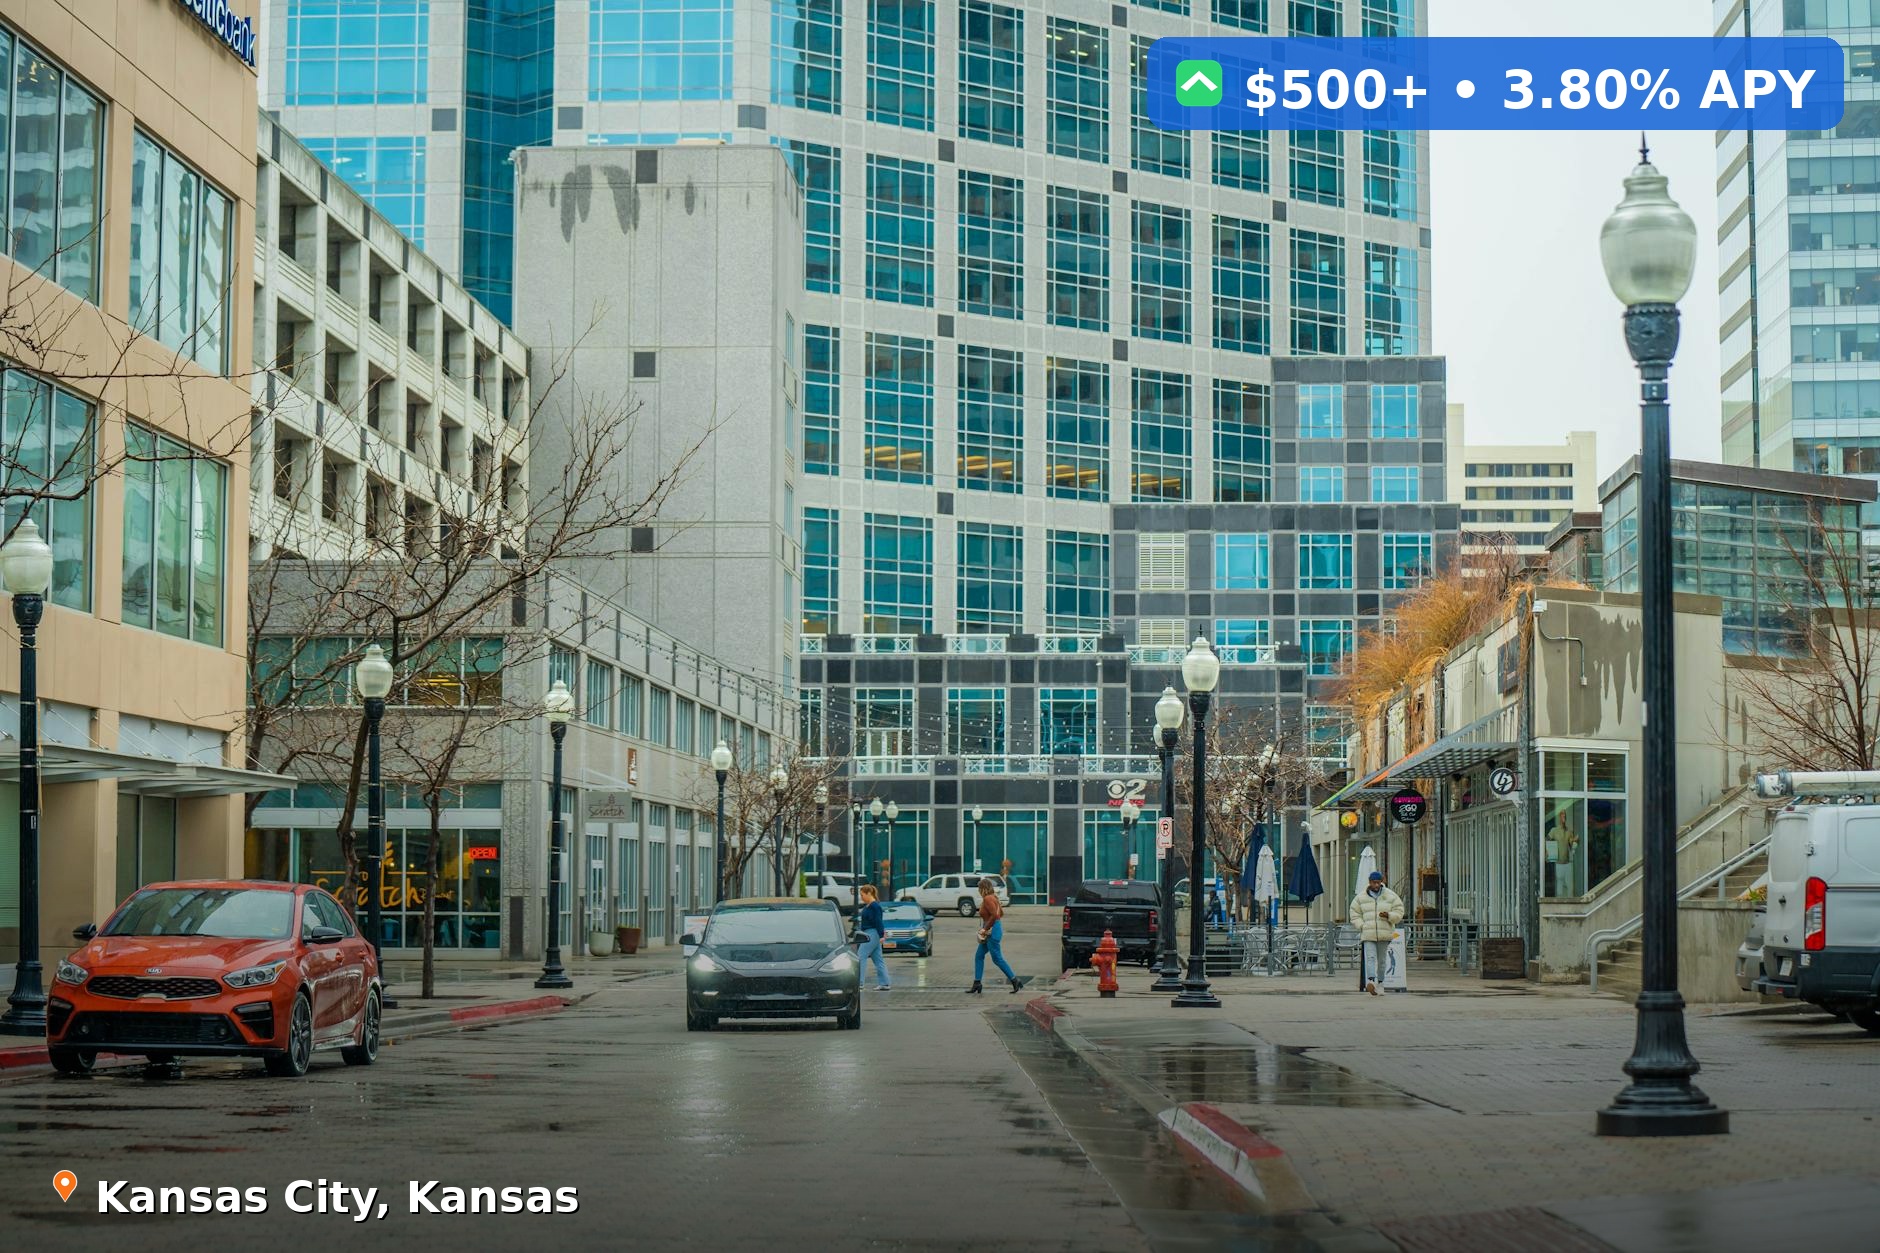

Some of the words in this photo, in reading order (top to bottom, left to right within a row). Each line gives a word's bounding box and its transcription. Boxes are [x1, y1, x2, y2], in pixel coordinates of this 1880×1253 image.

[184, 0, 256, 67] ticbank
[1126, 779, 1147, 800] 2
[470, 849, 496, 858] OPEN
[316, 876, 424, 908] atch
